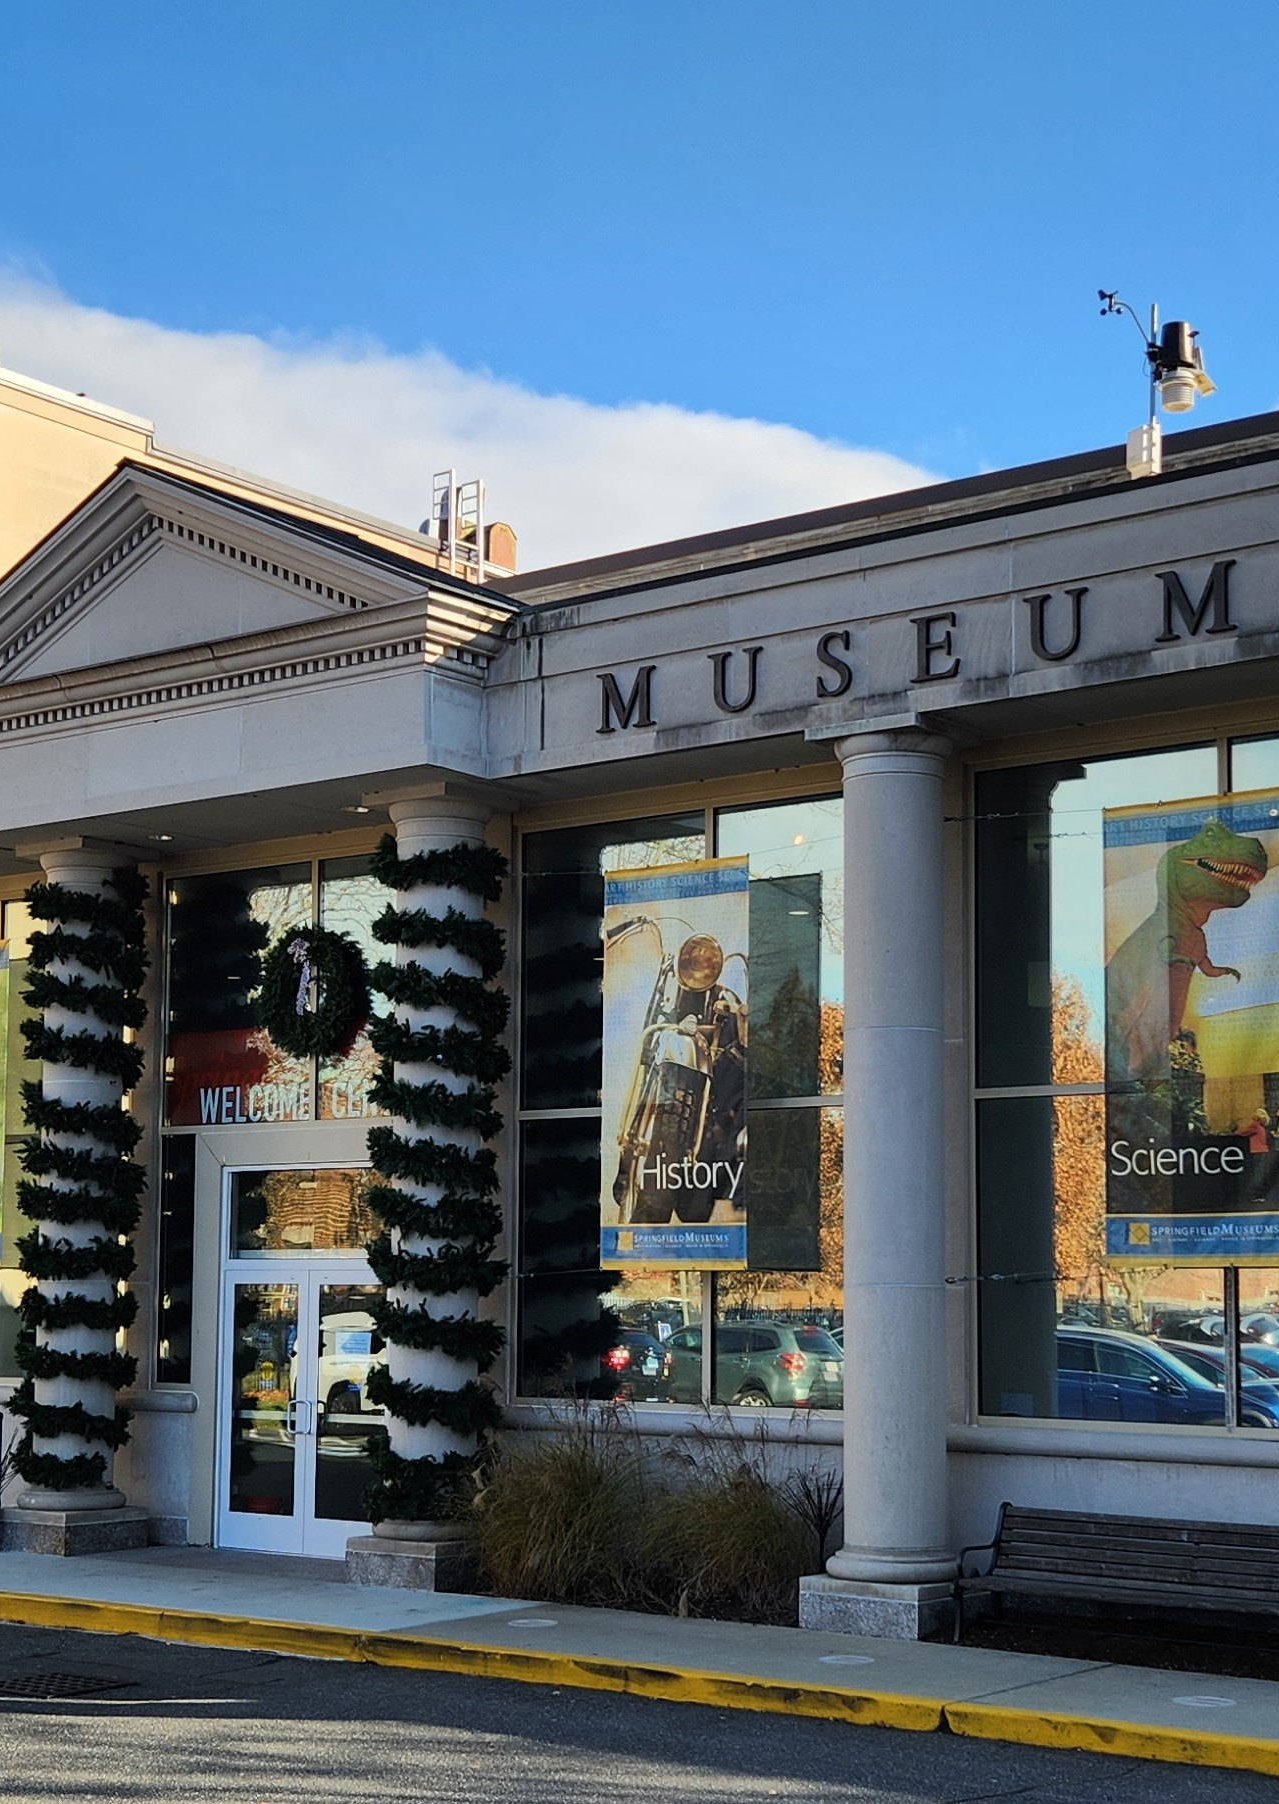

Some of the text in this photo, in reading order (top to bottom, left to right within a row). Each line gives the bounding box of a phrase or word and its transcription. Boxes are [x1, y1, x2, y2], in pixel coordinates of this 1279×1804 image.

[1130, 815, 1187, 830] HISTORY
[625, 878, 668, 892] HISTORY
[672, 872, 714, 887] SCIENCE
[200, 1078, 378, 1124] WELCOME CEN
[639, 1152, 745, 1199] History
[1111, 1138, 1244, 1176] Science
